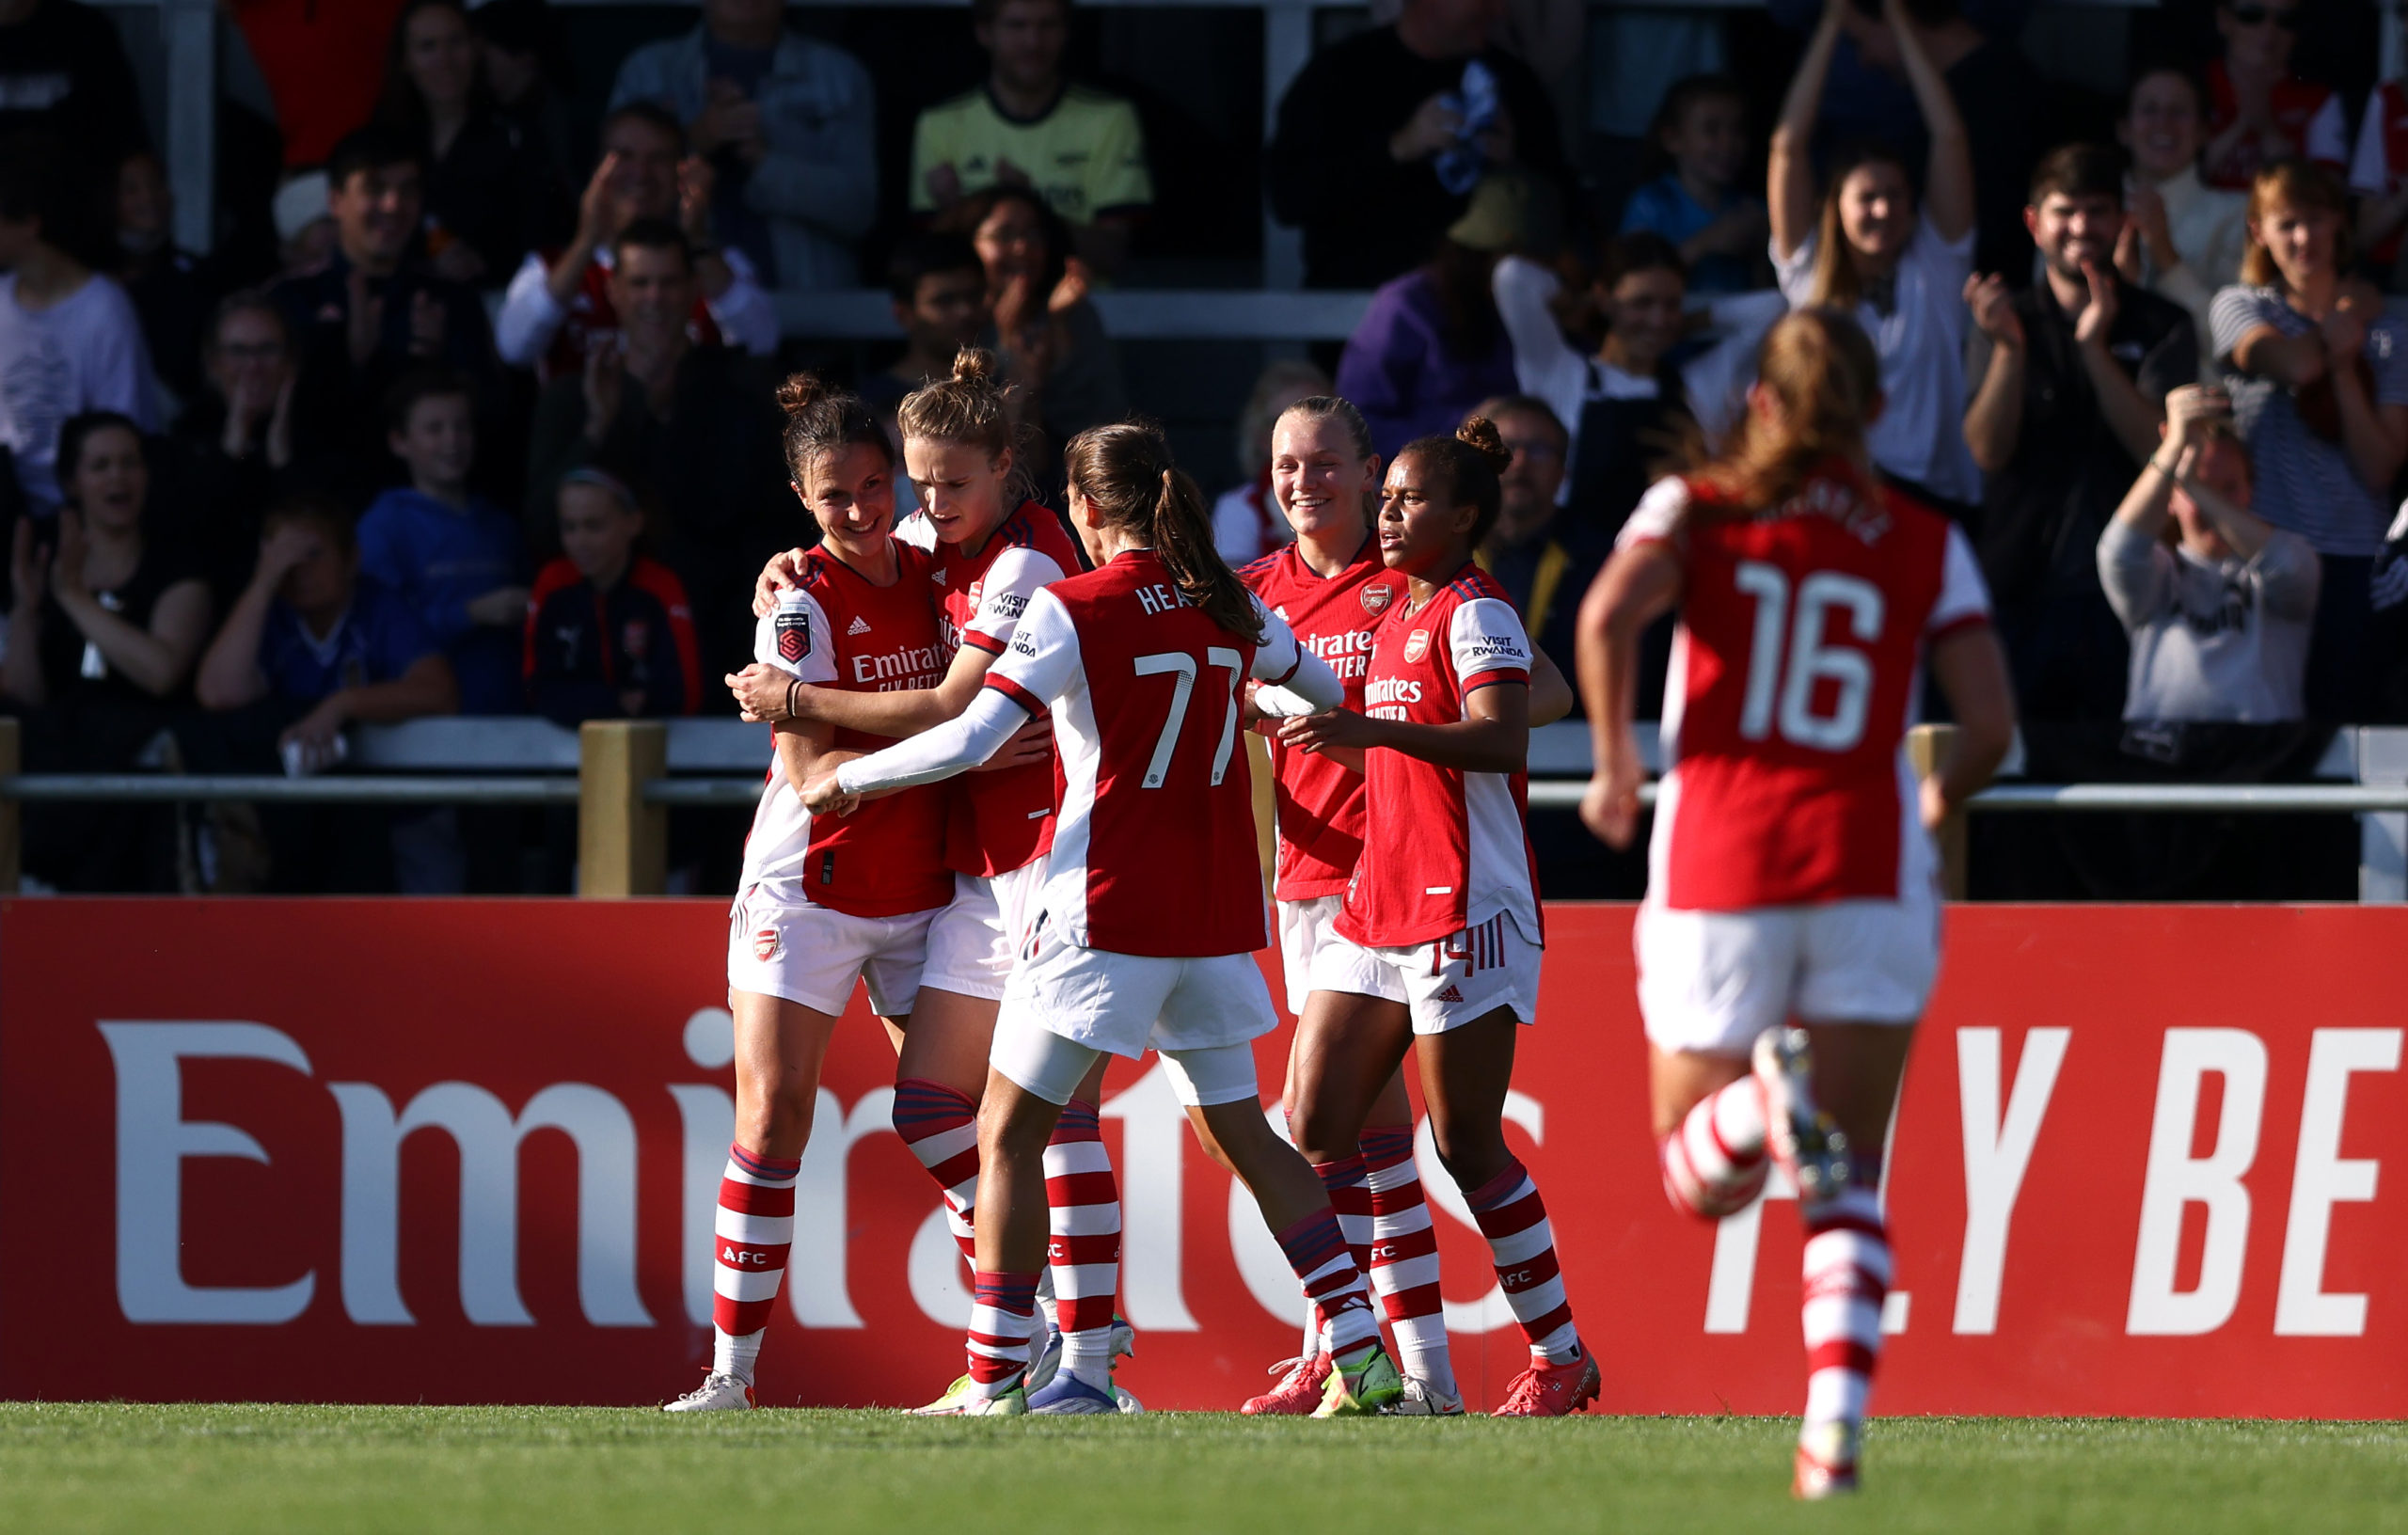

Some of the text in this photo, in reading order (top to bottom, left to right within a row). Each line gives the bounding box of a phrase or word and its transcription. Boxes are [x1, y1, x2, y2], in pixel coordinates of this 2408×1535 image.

[999, 593, 1030, 609] VISIT
[847, 625, 872, 636] adidas
[1482, 636, 1512, 646] VISIT
[1009, 641, 1037, 657] NDA
[1299, 628, 1373, 658] irate
[1472, 646, 1526, 658] RWANDA
[1324, 655, 1367, 679] TTER
[1735, 561, 1885, 752] 16
[1133, 646, 1244, 789] 77
[1431, 926, 1474, 977] 14
[2125, 1026, 2404, 1337] BE
[722, 1245, 768, 1265] AFC
